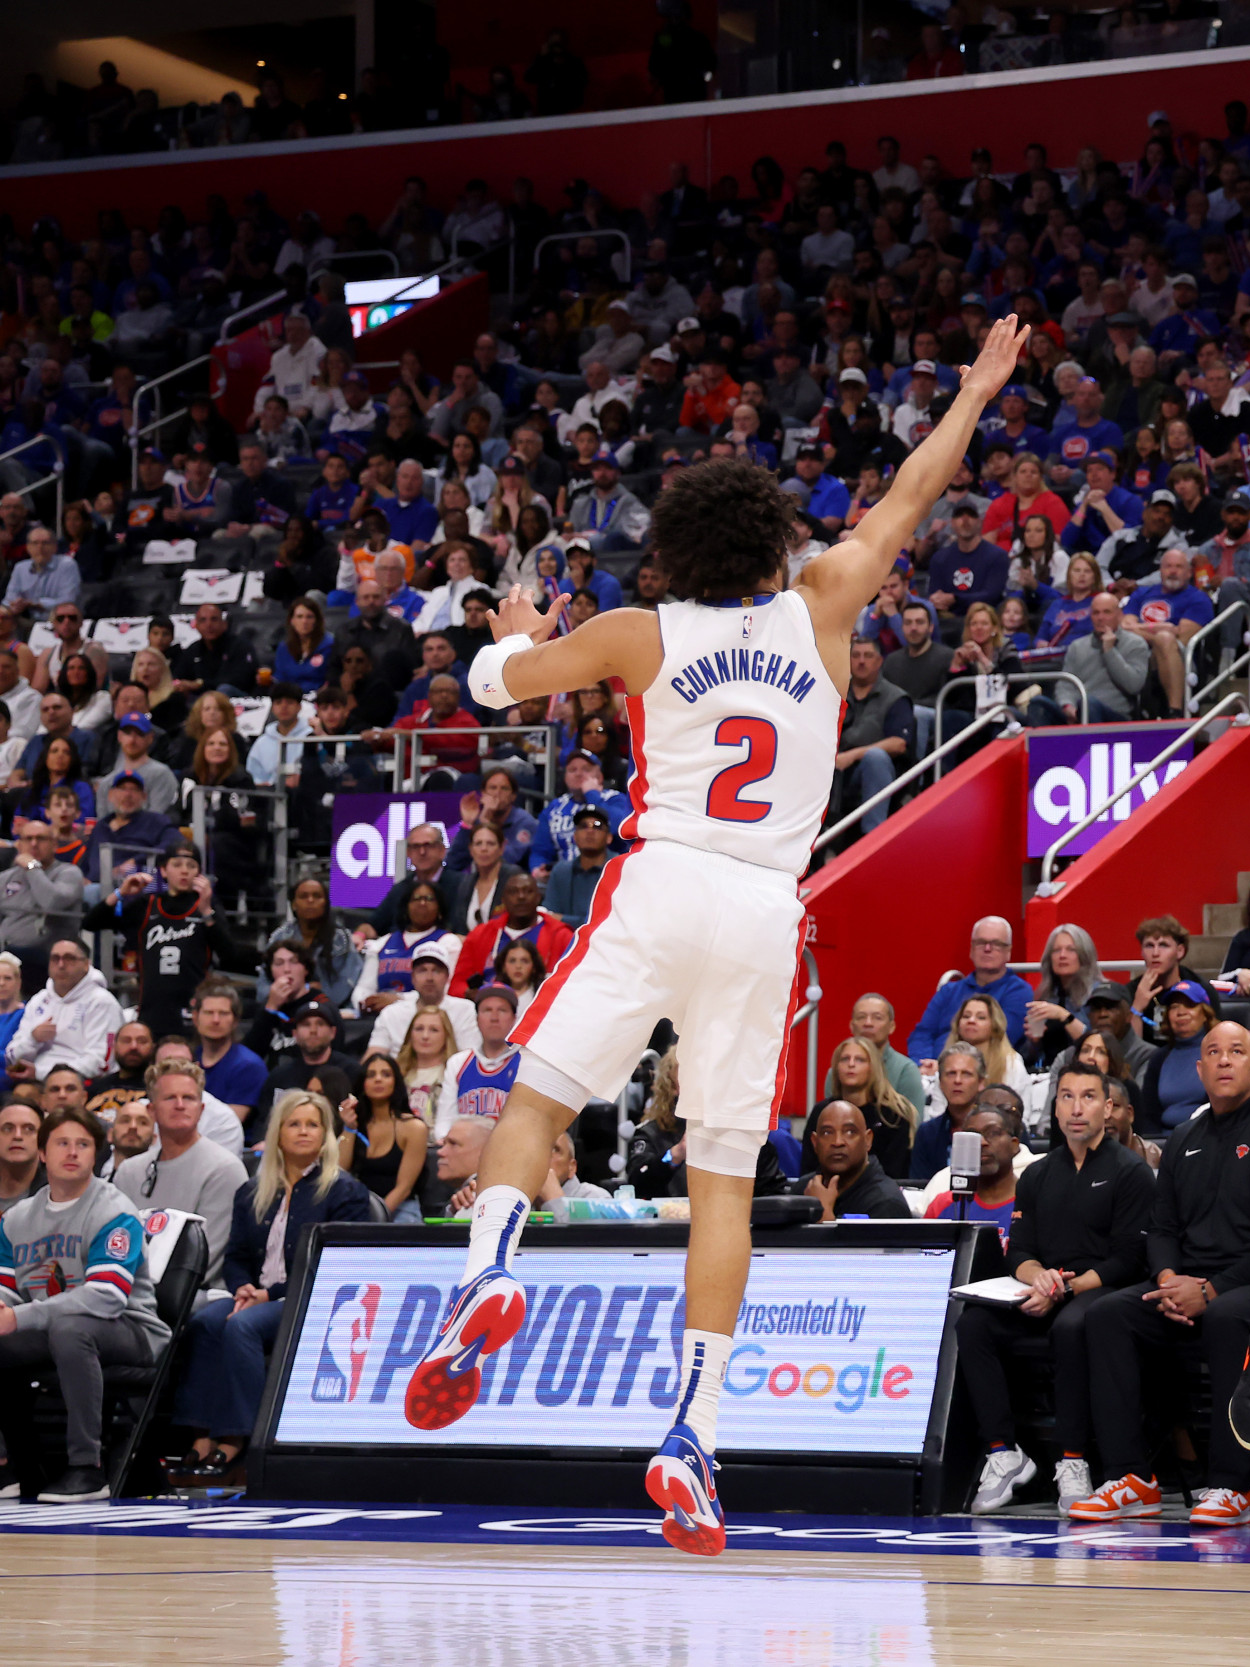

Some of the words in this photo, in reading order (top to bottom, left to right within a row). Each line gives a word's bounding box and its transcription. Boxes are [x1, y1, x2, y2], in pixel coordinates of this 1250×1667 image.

[670, 648, 816, 703] CUNNINGHAM
[705, 715, 778, 823] 2
[146, 923, 196, 950] Detroit
[159, 945, 181, 976] 2
[458, 1087, 509, 1116] PISTON
[736, 1296, 838, 1336] Presented
[842, 1301, 865, 1342] by
[370, 1284, 690, 1409] PYOFFS
[315, 1376, 343, 1397] NBA
[723, 1344, 913, 1413] Google
